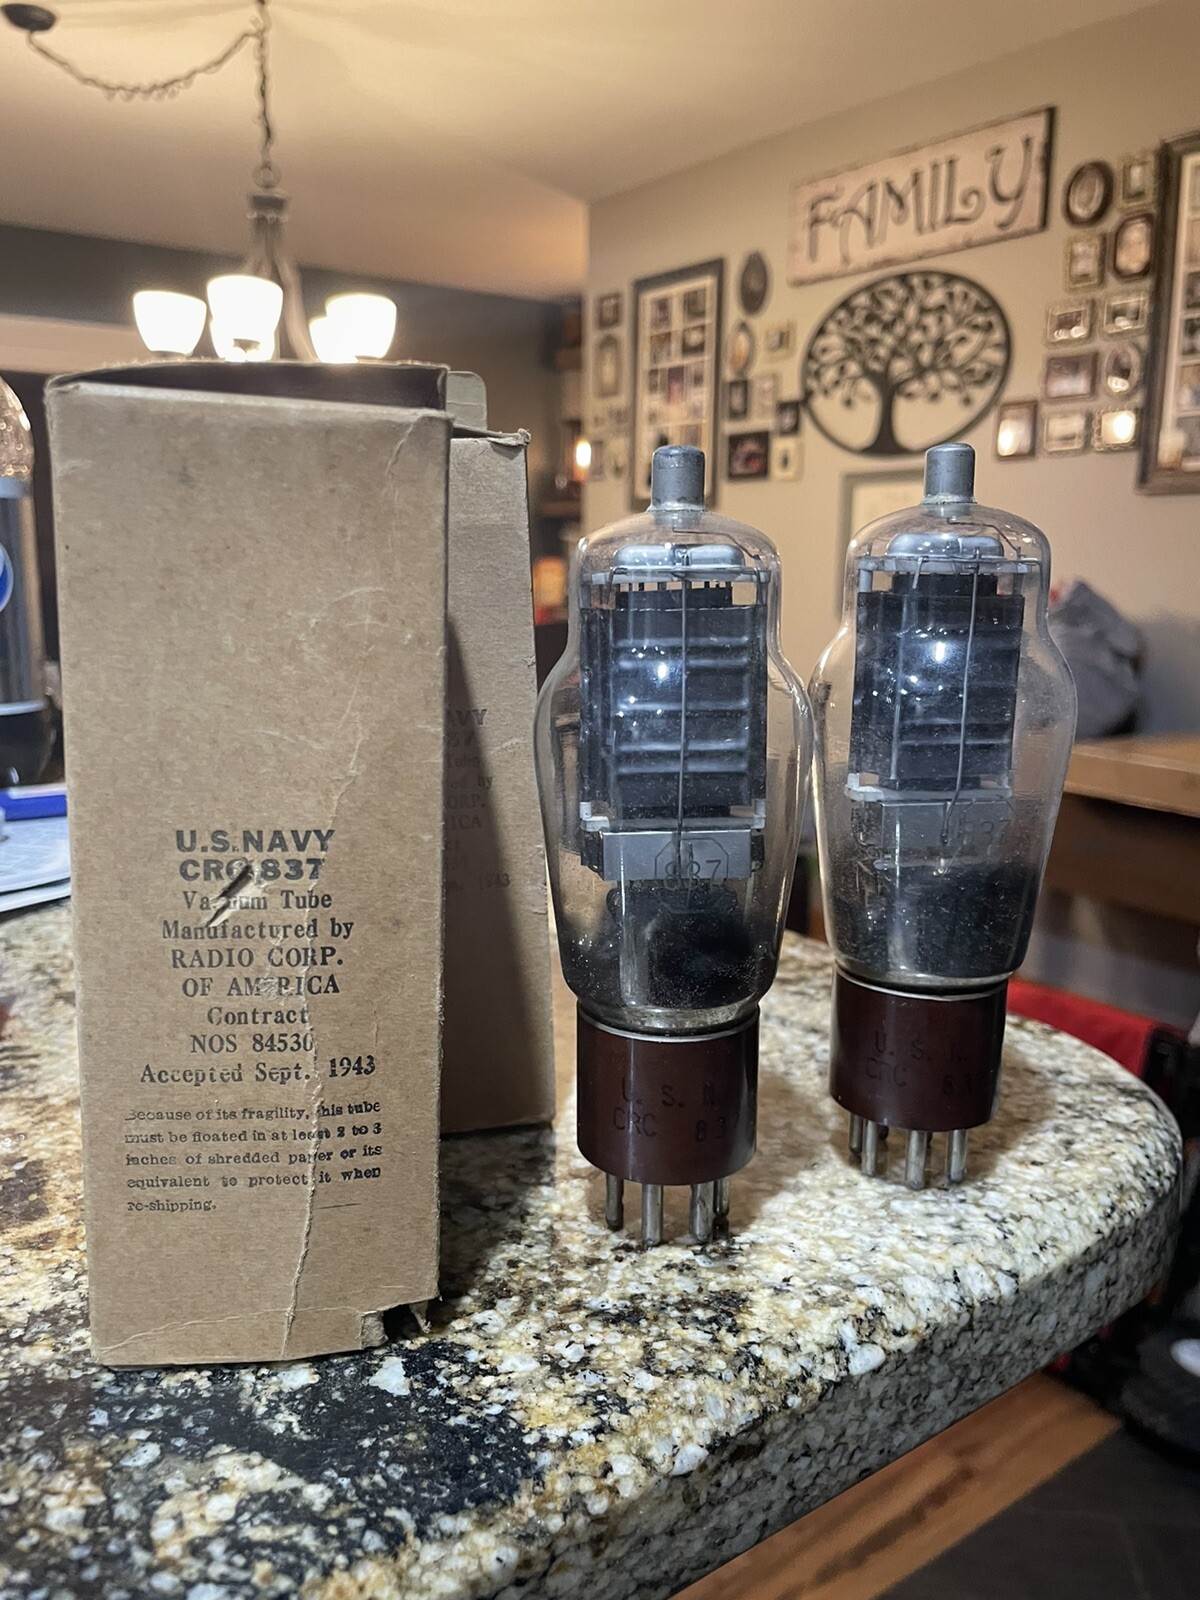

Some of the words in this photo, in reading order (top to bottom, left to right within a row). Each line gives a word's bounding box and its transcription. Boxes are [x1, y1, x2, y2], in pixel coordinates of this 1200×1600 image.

[806, 133, 1034, 266] FAMILY
[183, 890, 268, 910] Vauum
[280, 889, 333, 910] Tube
[162, 917, 318, 940] Manufactured
[330, 918, 354, 939] by
[171, 948, 254, 968] RADIO
[267, 946, 344, 968] CORP.
[182, 978, 213, 997] OF
[227, 974, 340, 997] AMRICA
[207, 1006, 309, 1026] Contract
[190, 1034, 237, 1053] NOS
[140, 1064, 244, 1087] Accepted
[255, 1062, 310, 1085] Sept.
[328, 1055, 376, 1078] 1943
[196, 1109, 213, 1120] of
[217, 1108, 237, 1119] its
[348, 1101, 381, 1115] tube
[125, 1132, 164, 1143] must
[168, 1131, 187, 1142] be
[192, 1130, 248, 1142] floated
[252, 1130, 266, 1141] in
[271, 1131, 287, 1141] at
[337, 1126, 345, 1138] 2
[352, 1124, 369, 1136] to
[373, 1122, 382, 1134] 3
[126, 1154, 178, 1166] inches
[185, 1153, 202, 1164] of
[208, 1152, 280, 1164] shredded
[340, 1148, 357, 1160] or
[363, 1145, 382, 1157] its
[127, 1176, 210, 1190] equivalent
[221, 1176, 238, 1187] to
[248, 1173, 309, 1188] protect
[319, 1171, 331, 1184] it
[341, 1167, 381, 1181] when
[127, 1199, 217, 1213] re-shipping.
